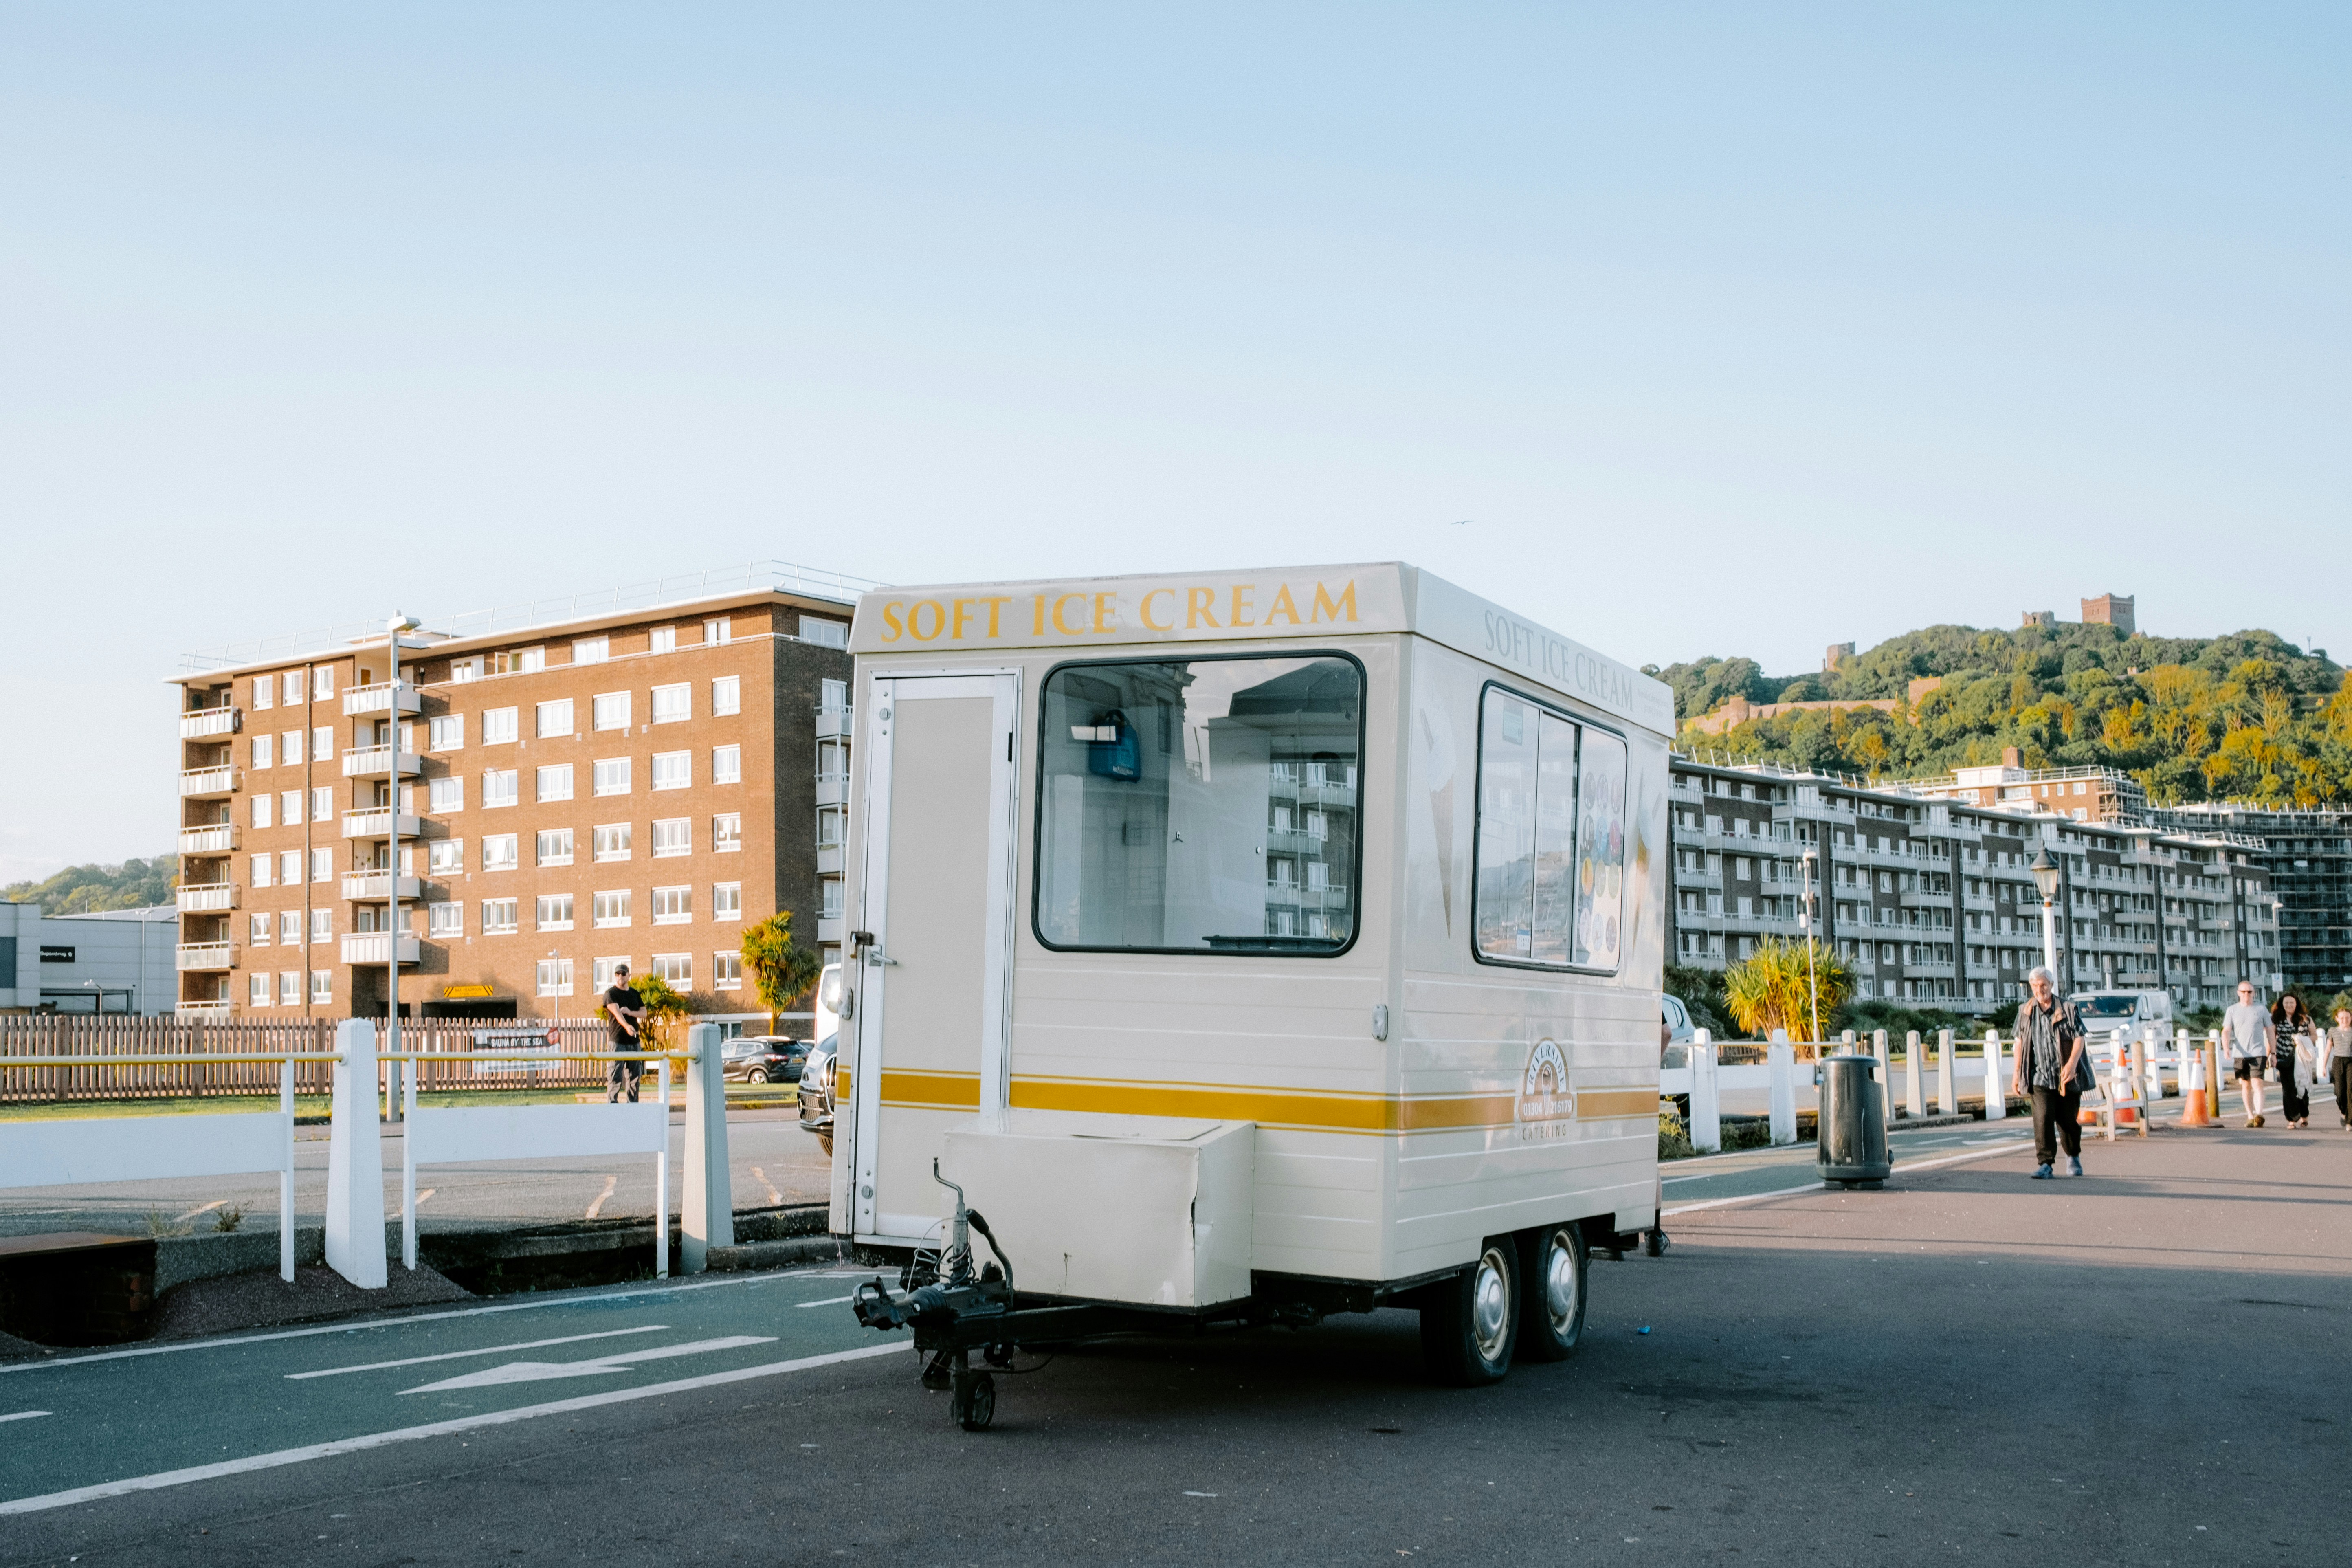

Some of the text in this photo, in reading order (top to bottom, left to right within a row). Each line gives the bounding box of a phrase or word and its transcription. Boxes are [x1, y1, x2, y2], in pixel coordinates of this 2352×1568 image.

[881, 578, 1363, 644] SOFT ICE CREAM
[1484, 610, 1633, 713] SOFT ICE CREAM
[491, 1037, 543, 1047] SAUNA BY THE SEA
[1529, 1044, 1565, 1087] RIVERSIDE
[1523, 1100, 1572, 1116] 01304 216179
[1522, 1124, 1566, 1141] CATERING
